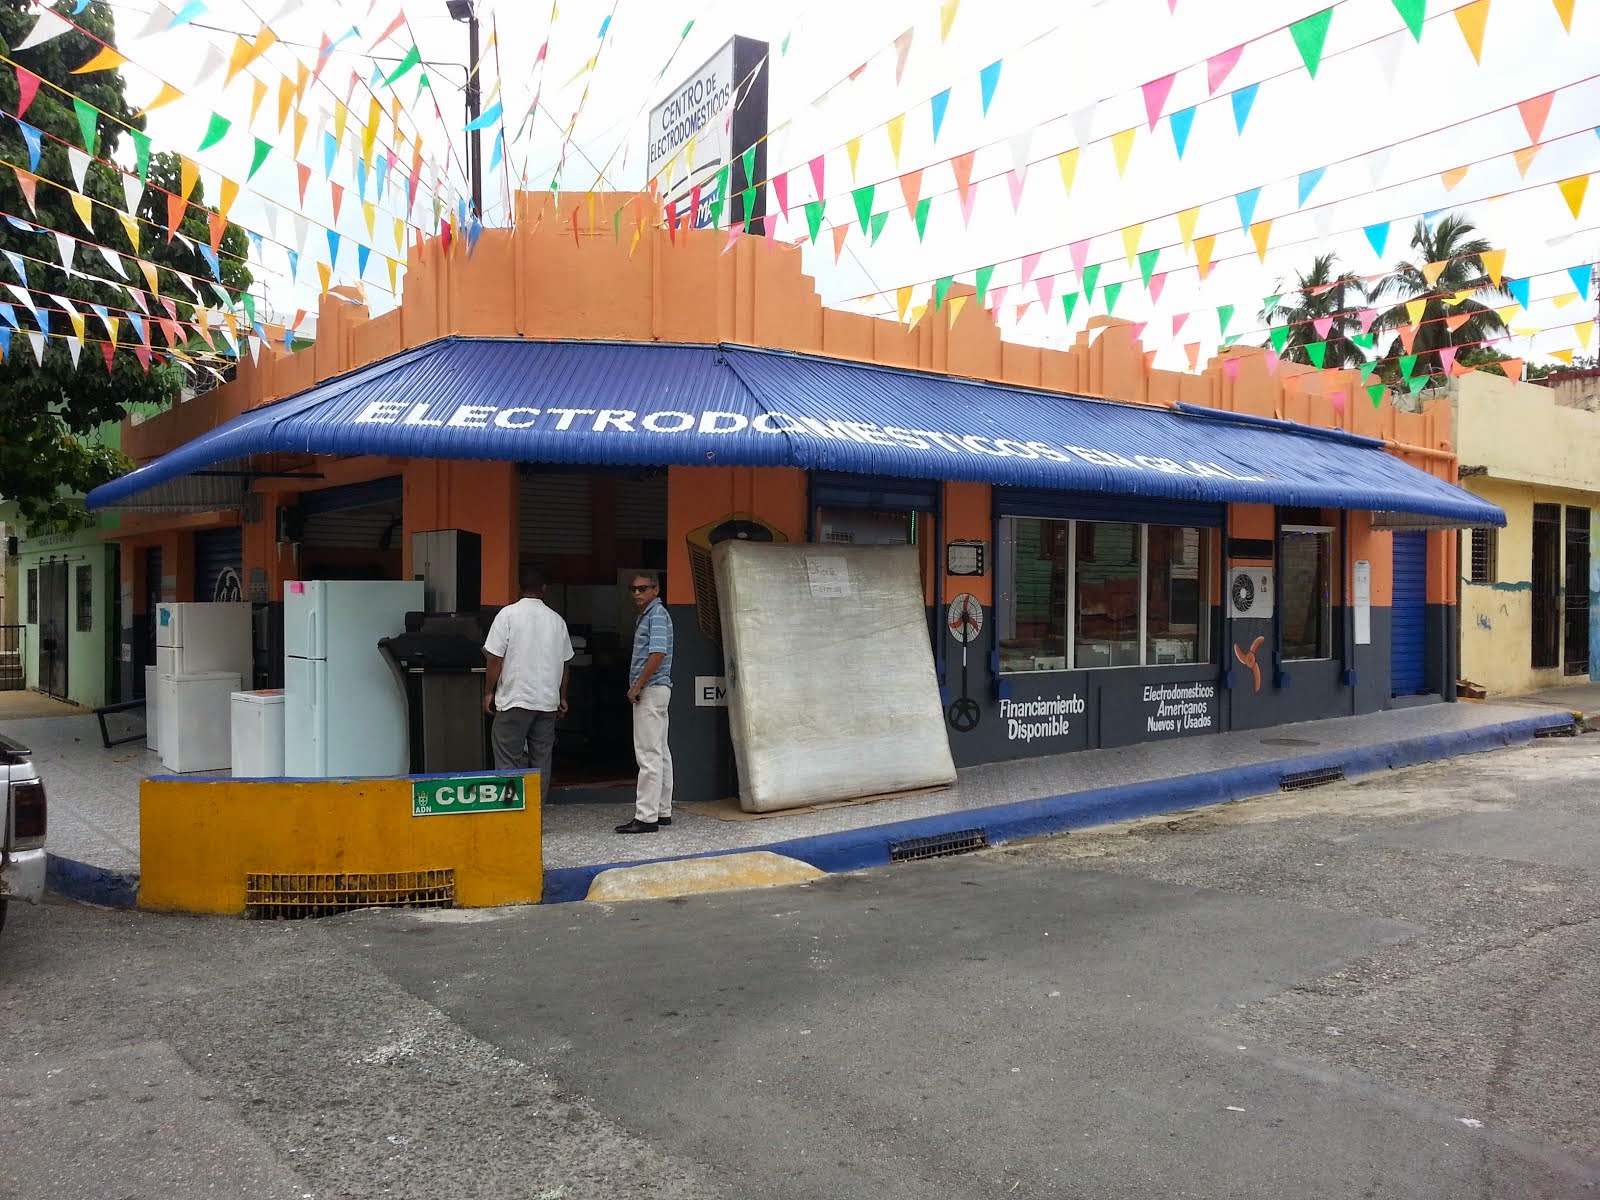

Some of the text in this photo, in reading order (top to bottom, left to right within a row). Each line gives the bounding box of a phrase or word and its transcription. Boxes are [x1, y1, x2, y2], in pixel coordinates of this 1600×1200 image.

[662, 73, 717, 131] CENTRO DE
[650, 83, 729, 163] ELECTRODOMESTICOS
[353, 400, 1071, 463] ELECTRODOMESTICOS
[1143, 682, 1214, 701] Electrodomesticos
[999, 693, 1084, 718] Financiamiento
[1157, 700, 1207, 717] Americanos
[1007, 715, 1069, 743] Disponible
[1147, 713, 1212, 732] Nuevos y Usados
[435, 784, 519, 805] CUBA
